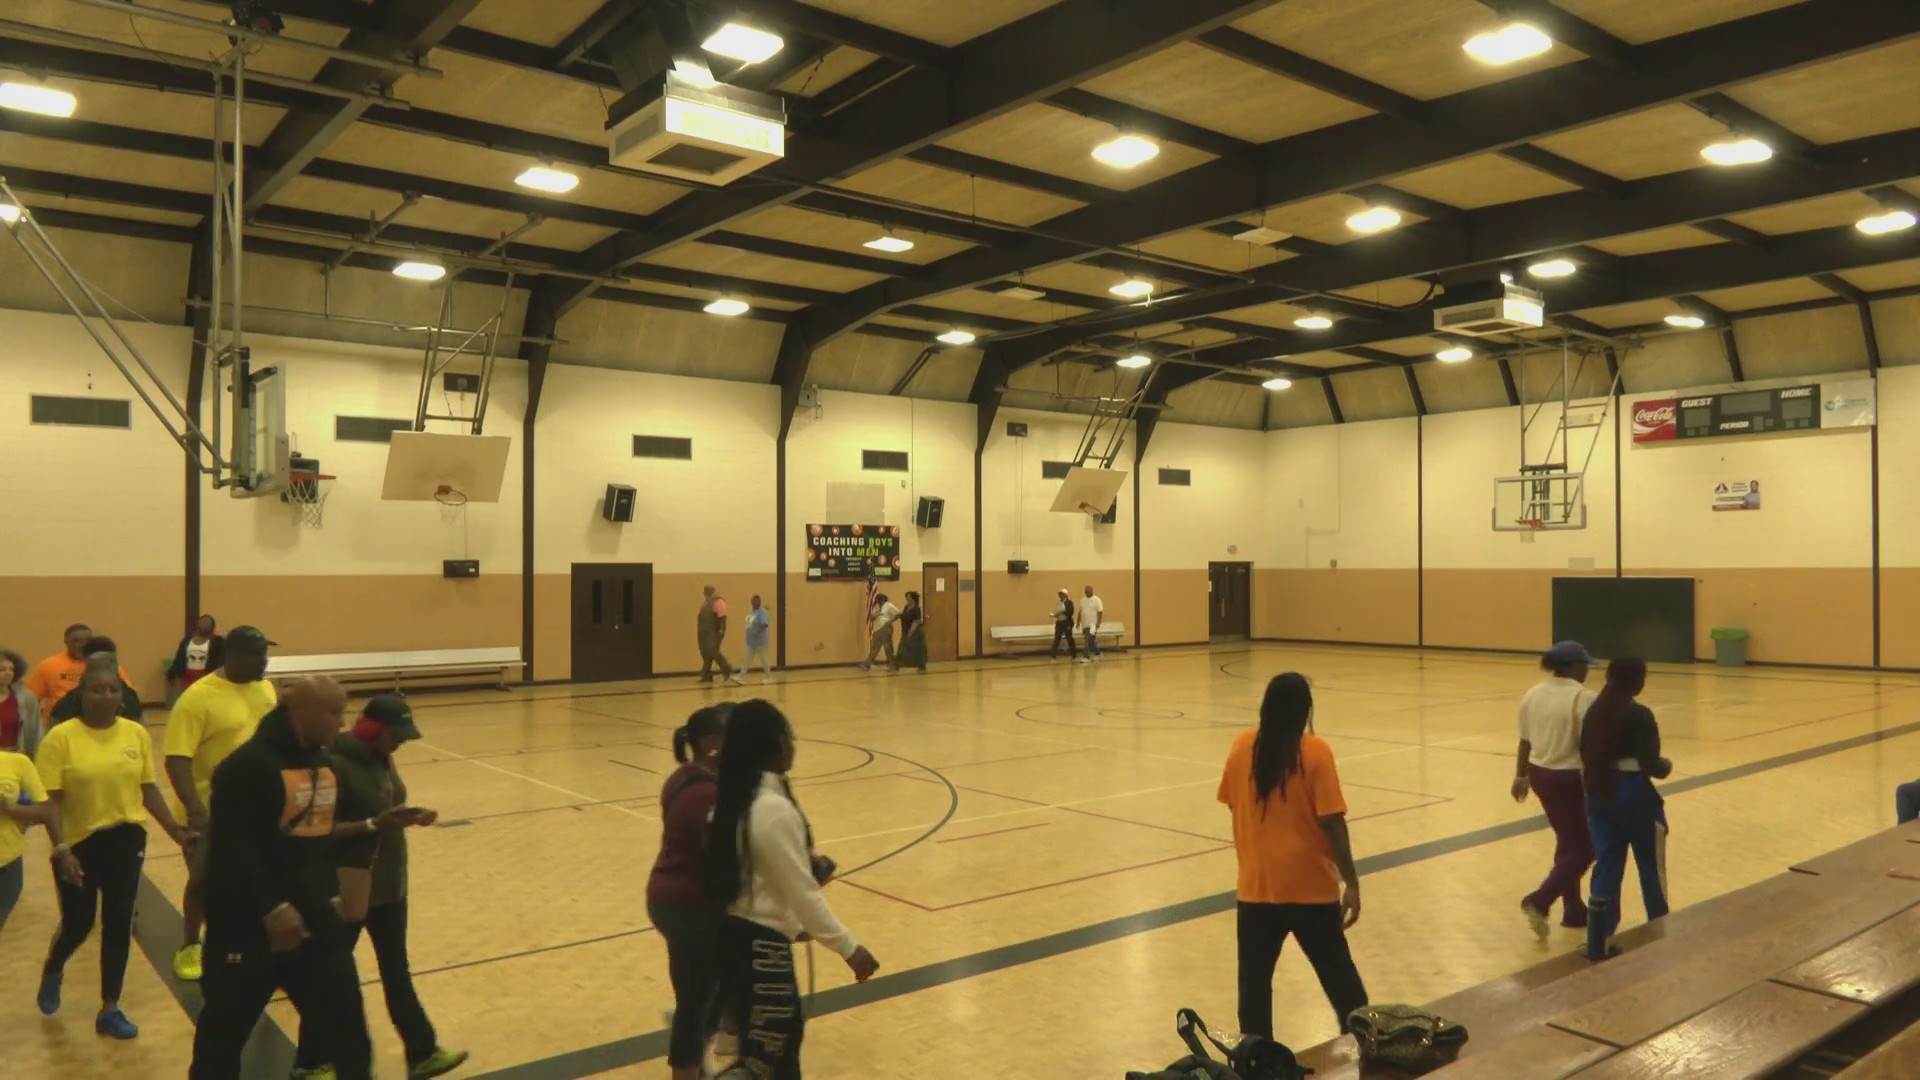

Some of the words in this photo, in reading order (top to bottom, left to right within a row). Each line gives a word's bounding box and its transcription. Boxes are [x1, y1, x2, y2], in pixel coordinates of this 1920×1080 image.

[1781, 387, 1812, 399] HOME
[1681, 397, 1713, 408] GUEST
[1720, 421, 1749, 430] PERIOD
[813, 536, 865, 546] COACHING
[868, 537, 893, 547] BOYS
[828, 547, 853, 556] INTO
[857, 547, 879, 557] MEN
